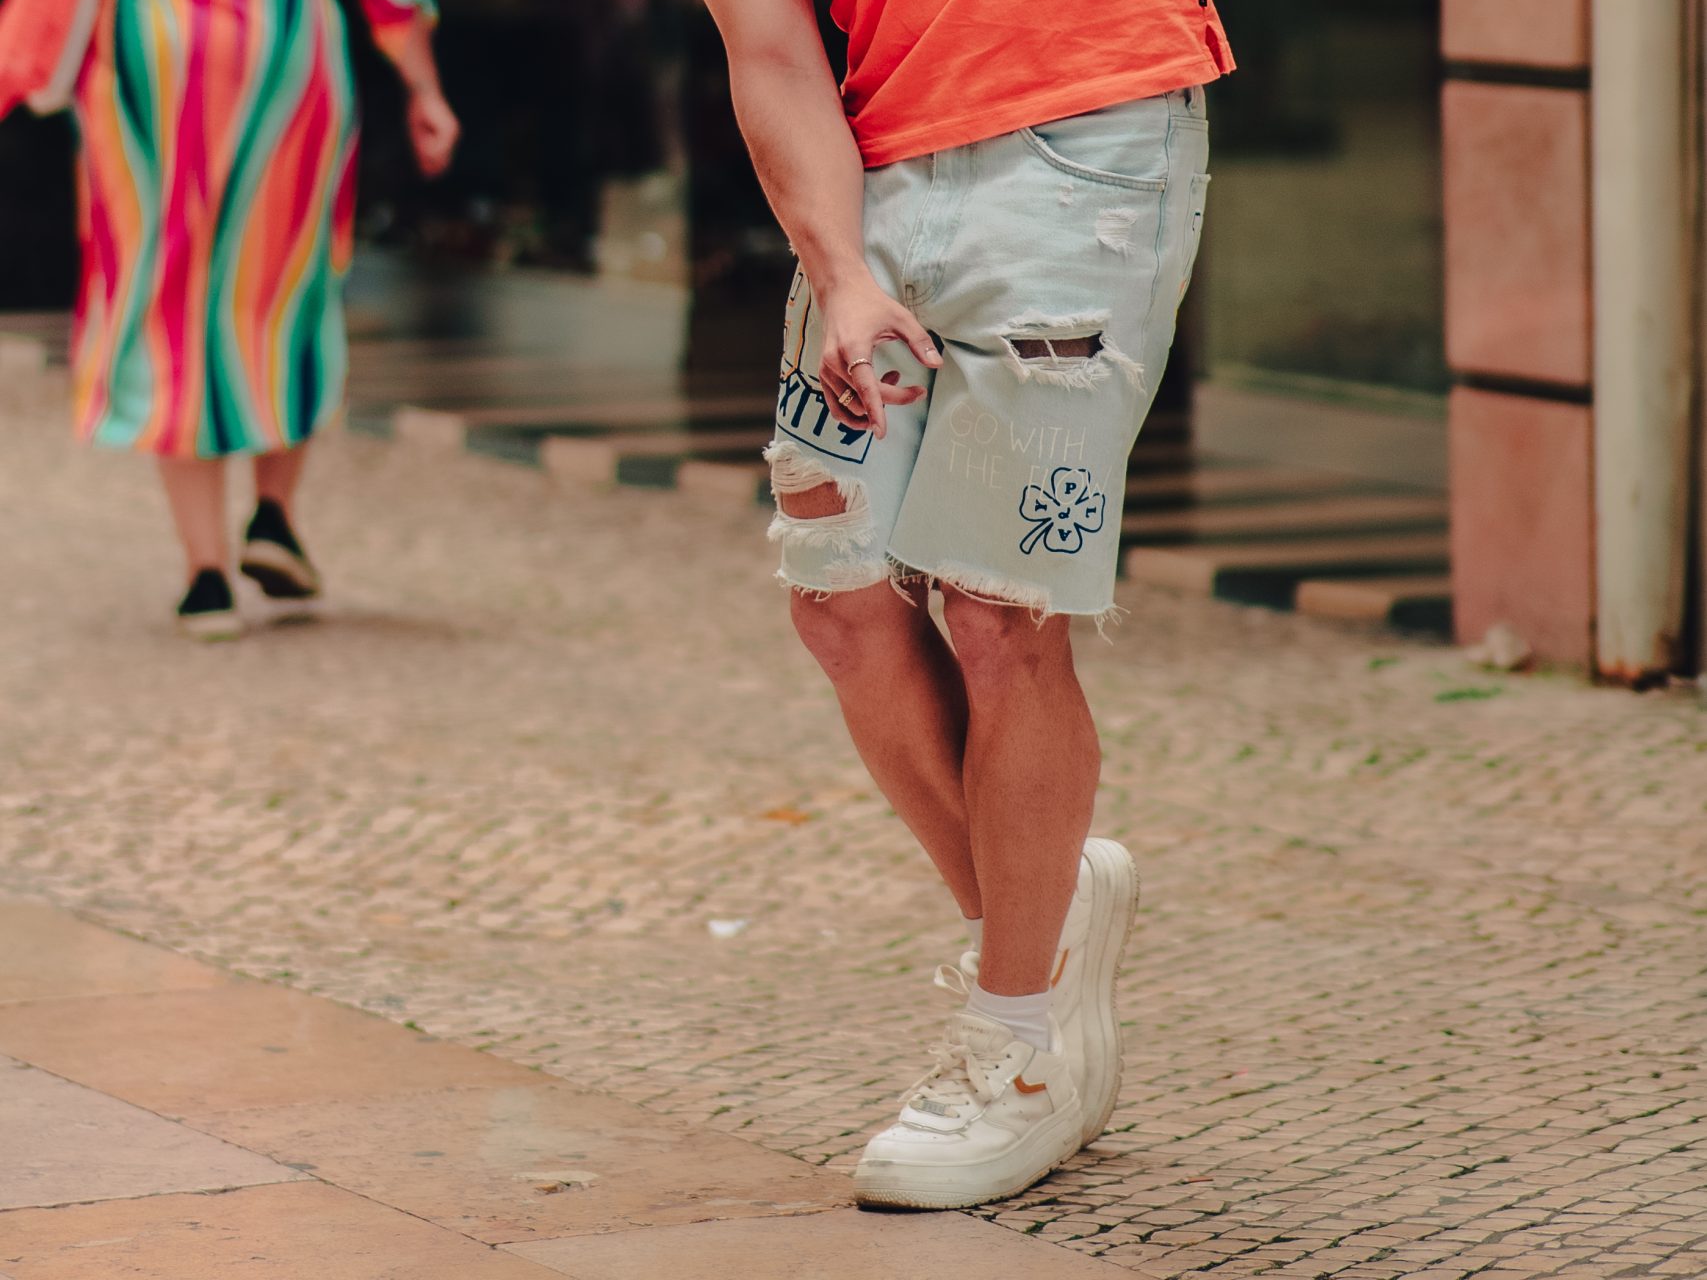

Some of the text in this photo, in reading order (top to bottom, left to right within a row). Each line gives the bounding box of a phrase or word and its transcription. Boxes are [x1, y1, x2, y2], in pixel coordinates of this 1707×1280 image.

[950, 401, 1087, 462] GO WITH
[949, 440, 1004, 489] THE
